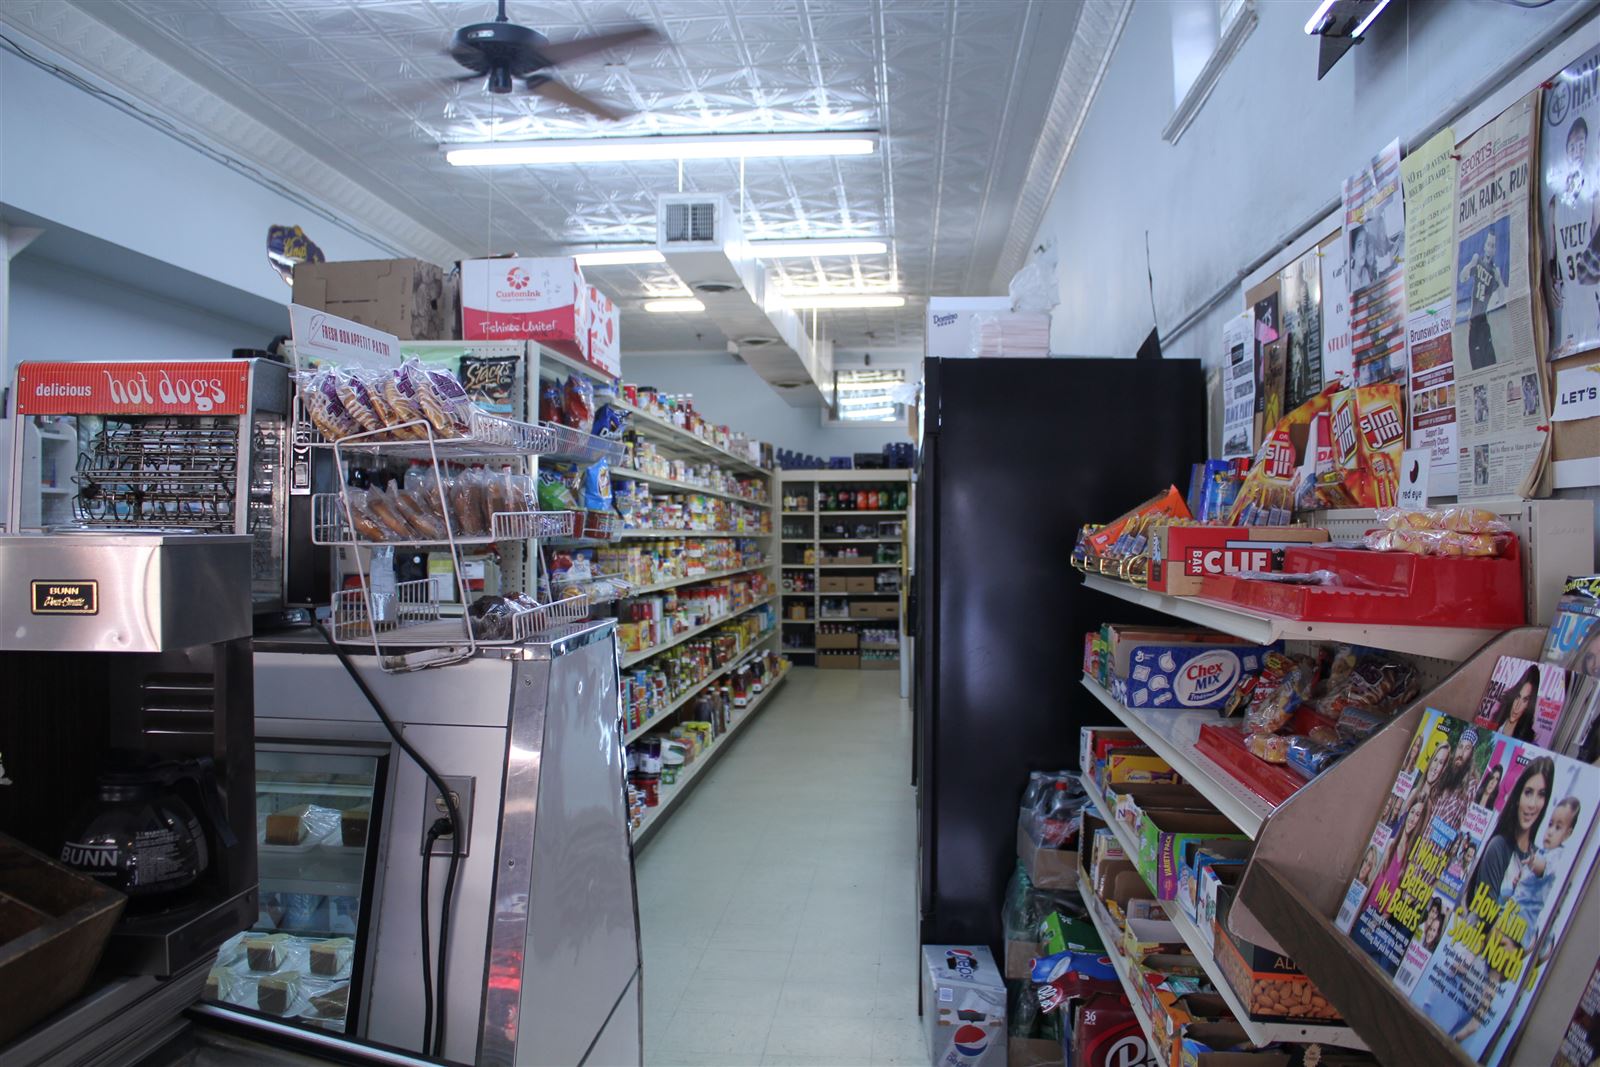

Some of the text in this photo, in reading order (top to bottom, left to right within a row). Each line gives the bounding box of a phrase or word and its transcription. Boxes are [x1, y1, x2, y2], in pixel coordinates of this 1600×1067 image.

[1461, 141, 1492, 178] SPORTS
[1459, 194, 1478, 223] RUN,
[1479, 176, 1506, 210] RAMS,
[1560, 221, 1587, 250] VCU
[1476, 264, 1493, 287] VCU
[933, 312, 958, 325] Domino
[321, 324, 338, 342] FRESH
[339, 329, 350, 344] BON
[350, 331, 371, 351] APPETIT
[1410, 322, 1439, 343] Brunswick
[35, 382, 92, 398] delicious
[464, 363, 512, 390] Stacy's
[103, 370, 226, 411] hot dogs
[1561, 387, 1597, 405] LET'S
[1333, 405, 1352, 439] slim
[1359, 409, 1398, 434] slim
[1372, 421, 1403, 448] jim
[1338, 423, 1356, 464] jim
[1402, 489, 1422, 500] red eye
[1192, 550, 1267, 574] BAR CLIF
[49, 587, 79, 595] BUNN
[1186, 662, 1224, 680] Chex
[60, 846, 119, 867] BUNN
[1164, 835, 1173, 877] VARIETY PACK
[1408, 835, 1422, 860] I
[1416, 840, 1448, 880] Won't
[1400, 863, 1434, 910] Betray
[1375, 879, 1392, 914] My
[1387, 887, 1421, 932] Beliefs
[1469, 881, 1527, 942] How Kim
[1447, 906, 1524, 983] Spoils North
[1084, 1010, 1096, 1022] 36
